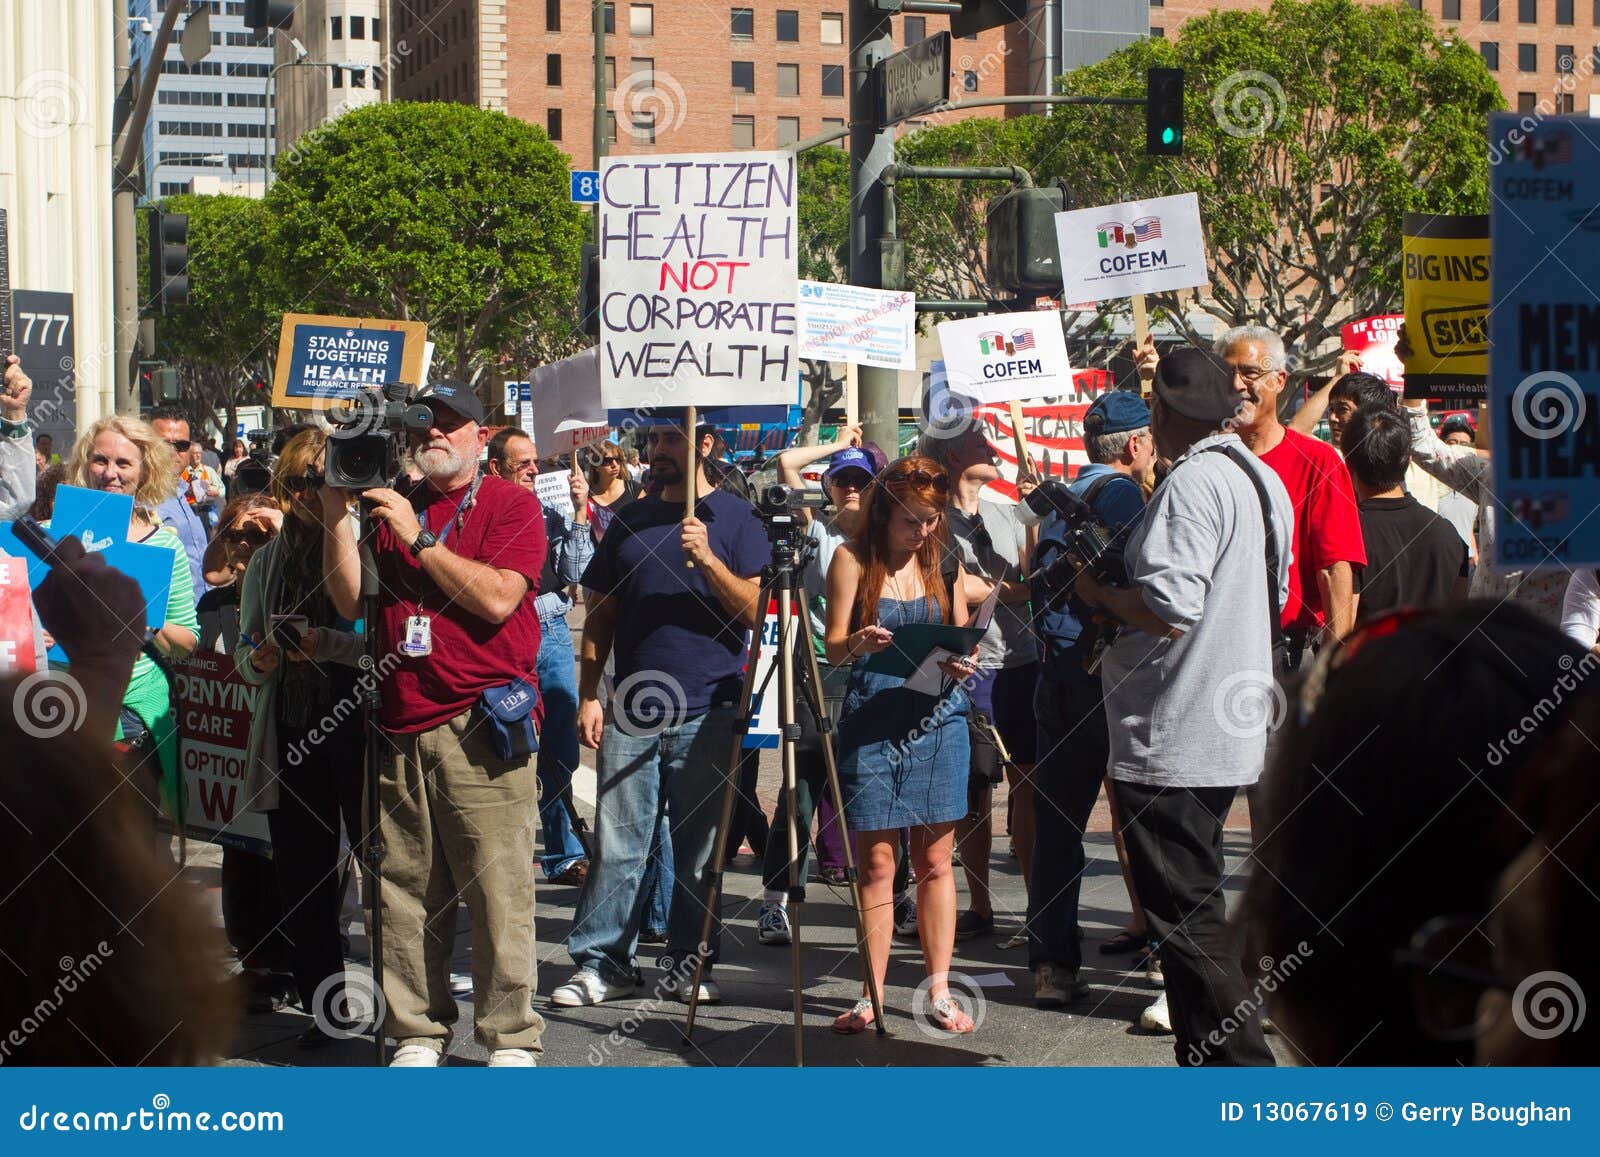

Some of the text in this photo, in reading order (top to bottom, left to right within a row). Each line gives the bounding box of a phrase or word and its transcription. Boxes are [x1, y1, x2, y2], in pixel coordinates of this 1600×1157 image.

[580, 176, 600, 197] 8t
[602, 156, 794, 209] CITIZEN
[602, 211, 791, 261] HEALTH
[1099, 249, 1168, 274] COFEM
[1405, 253, 1489, 282] BIG INS
[659, 260, 750, 294] NOT
[602, 292, 796, 335] CORPORATE
[1352, 321, 1368, 334] IF
[19, 312, 70, 347] 777
[308, 335, 389, 352] STANDING
[307, 348, 388, 365] TOGETHER
[606, 340, 789, 383] WEALTH
[983, 359, 1042, 379] COFEM
[302, 379, 348, 389] INSURANCE
[303, 364, 386, 383] HEALTH
[175, 674, 258, 714] DENYIN
[186, 710, 233, 738] CARE
